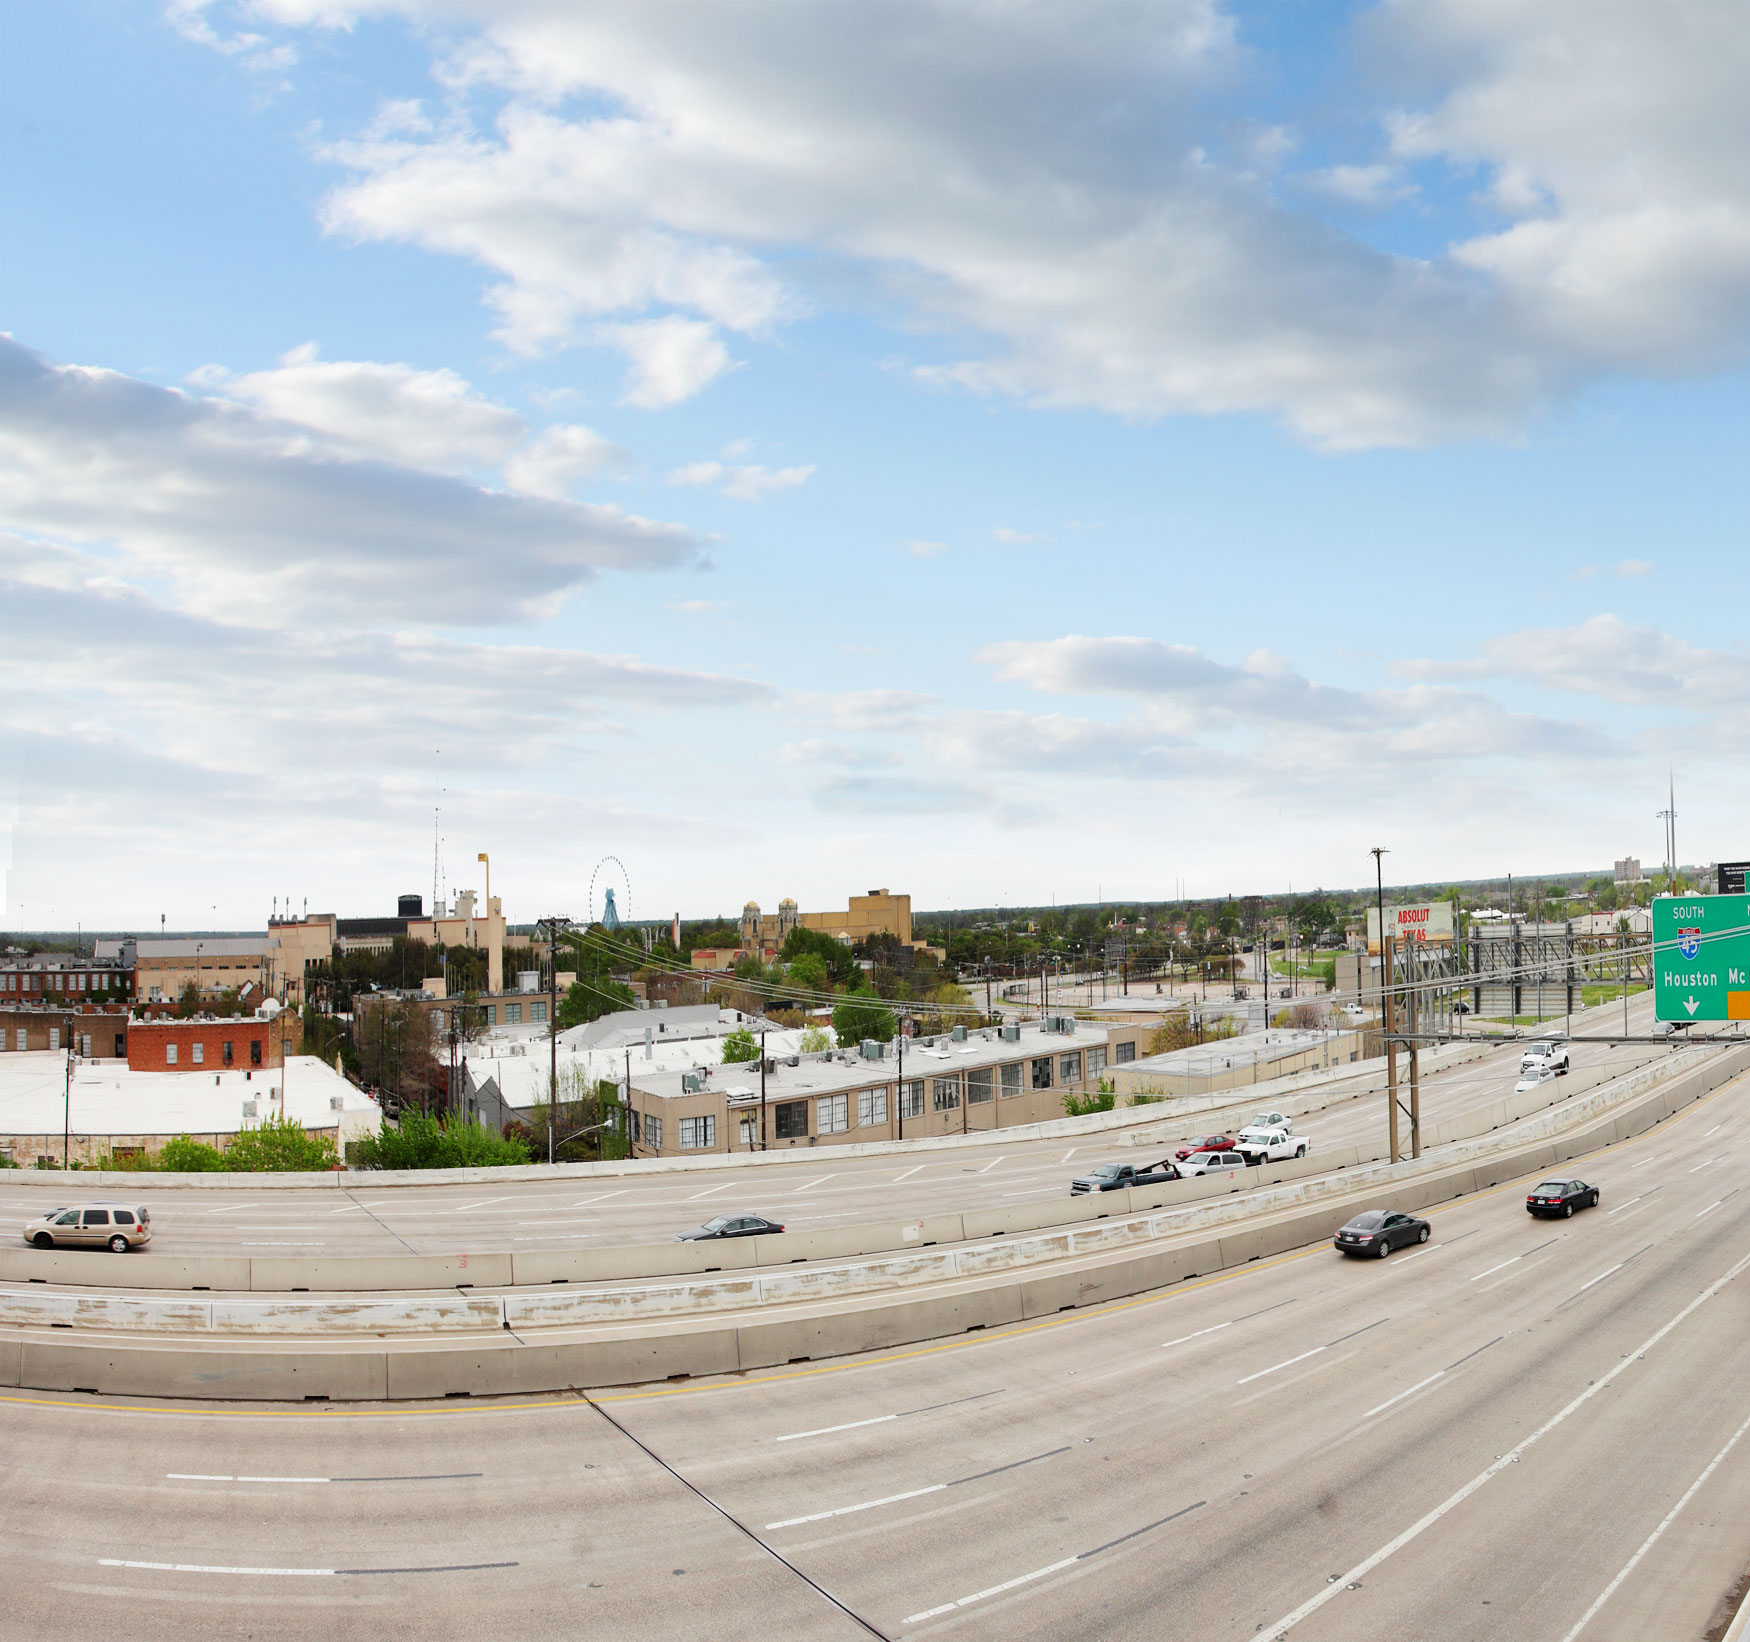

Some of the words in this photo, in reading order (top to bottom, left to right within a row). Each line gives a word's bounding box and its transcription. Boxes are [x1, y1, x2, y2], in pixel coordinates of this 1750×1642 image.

[1398, 908, 1429, 924] ABSOLUT
[1673, 906, 1705, 919] SOUTH
[1402, 928, 1426, 941] TAS
[1681, 935, 1698, 953] 45
[1664, 971, 1718, 987] Houston
